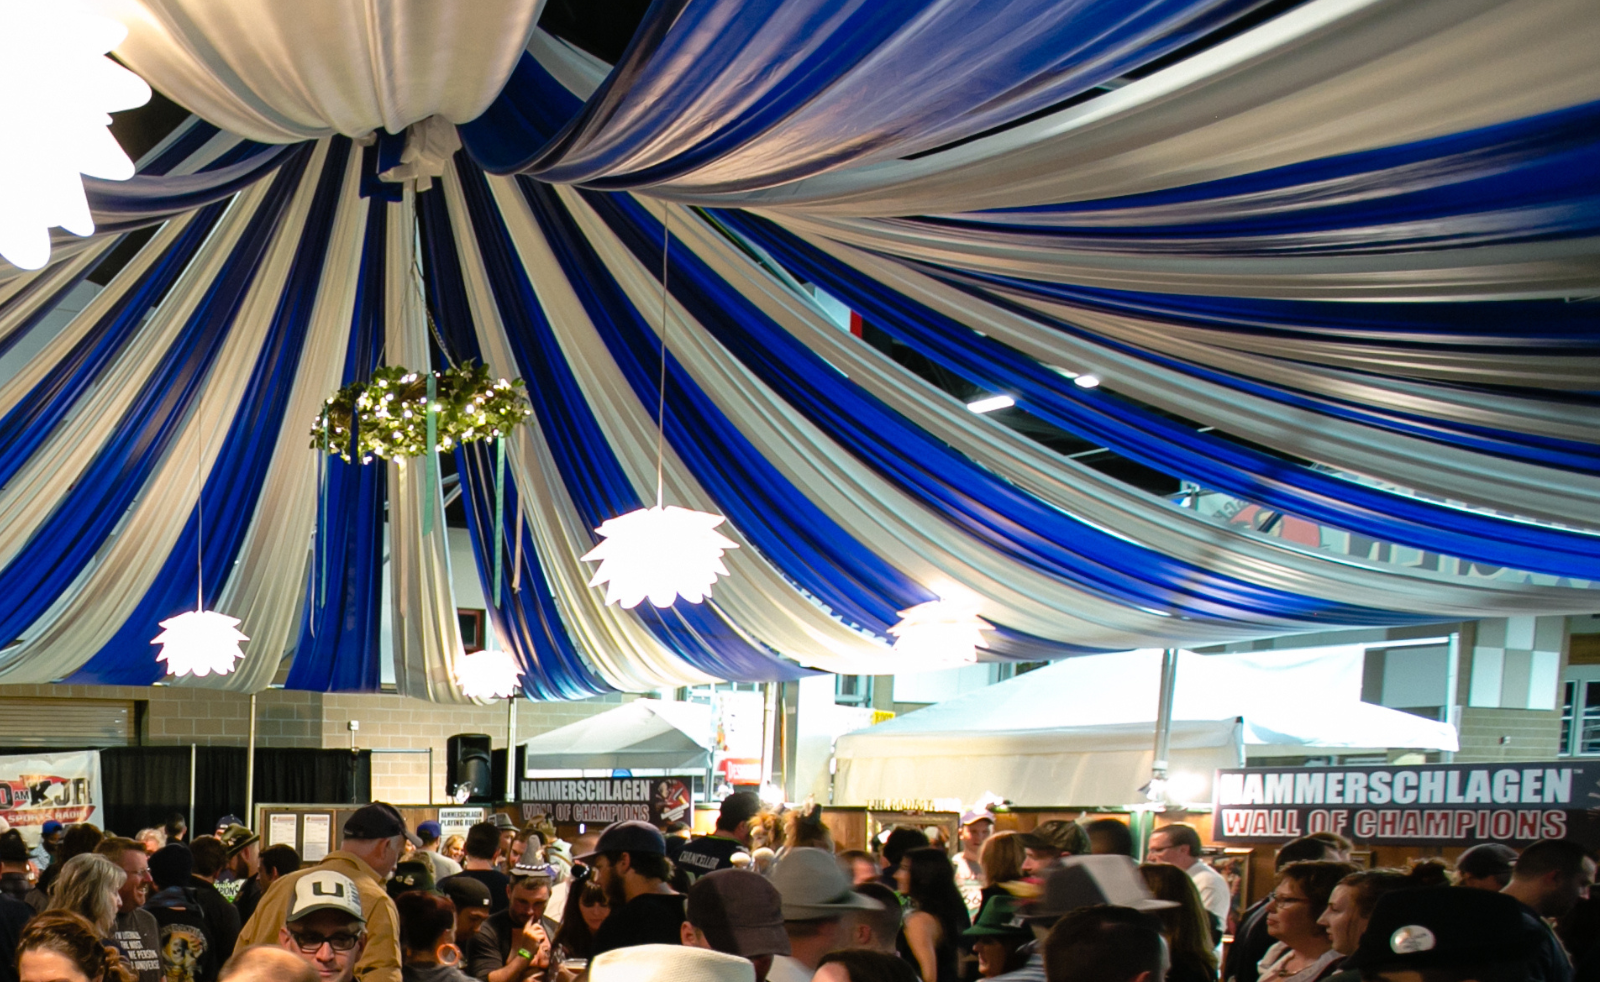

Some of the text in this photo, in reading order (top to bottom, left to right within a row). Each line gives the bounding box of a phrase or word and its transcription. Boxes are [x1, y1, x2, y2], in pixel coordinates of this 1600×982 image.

[14, 789, 30, 801] AM
[30, 777, 93, 806] KJR
[521, 780, 650, 801] HAMMERSCHLAGEN
[1220, 769, 1572, 805] HAMMERSCHLAGEN
[555, 803, 571, 821] OF
[572, 803, 650, 822] CHAMPIONS
[1222, 808, 1567, 840] WALL OF CHAMPIONS
